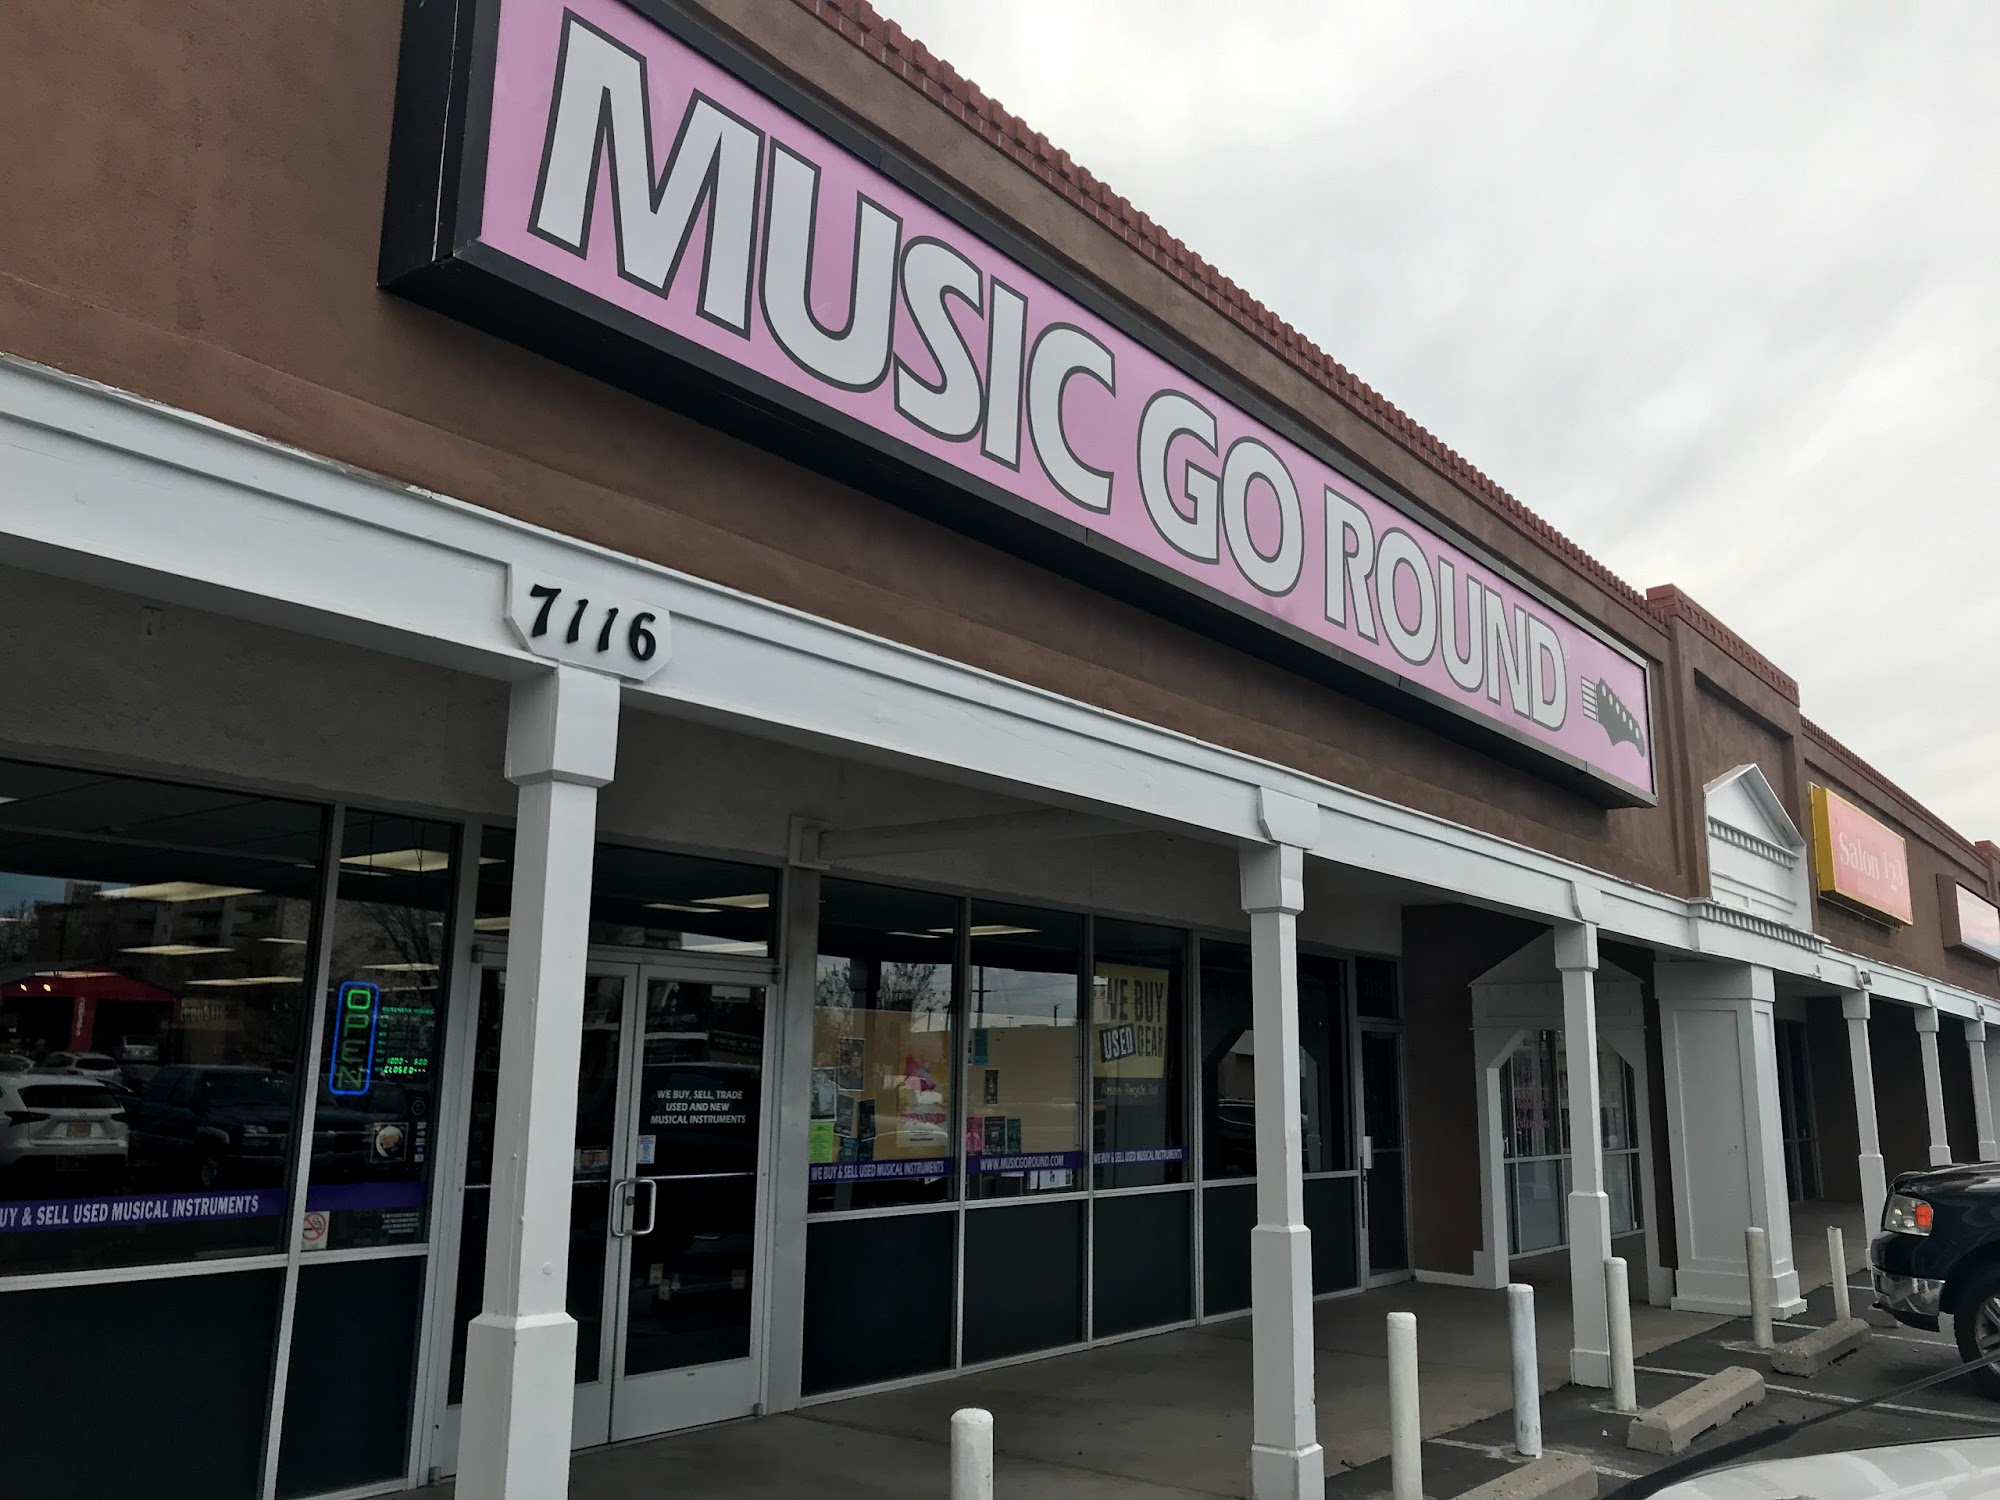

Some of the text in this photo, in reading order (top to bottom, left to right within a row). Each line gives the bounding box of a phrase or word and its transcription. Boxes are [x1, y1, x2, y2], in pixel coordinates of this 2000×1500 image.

[527, 6, 1567, 731] MUSIC GO ROUND
[530, 584, 656, 661] 7116
[1838, 832, 1904, 891] Salon 123
[1134, 980, 1163, 1023] BUY
[337, 988, 372, 1089] OPEN
[1103, 1025, 1164, 1060] USED GEAR
[657, 1090, 744, 1100] WE BUY, SELL, TRADE
[666, 1103, 730, 1112] USED AND NEW
[650, 1115, 747, 1125] MUSICAL INSTRUMENTS
[811, 1166, 823, 1181] WE
[823, 1166, 837, 1180] BUY
[844, 1165, 859, 1178] SELL
[860, 1164, 876, 1178] USED
[877, 1162, 903, 1177] MUSICAL
[904, 1160, 945, 1175] INSTRUMENTS
[22, 1207, 32, 1226] &
[36, 1205, 69, 1226] SELL
[73, 1203, 109, 1223] USED
[111, 1200, 169, 1221] MUSICAL
[172, 1195, 259, 1217] INSTRUMENTS
